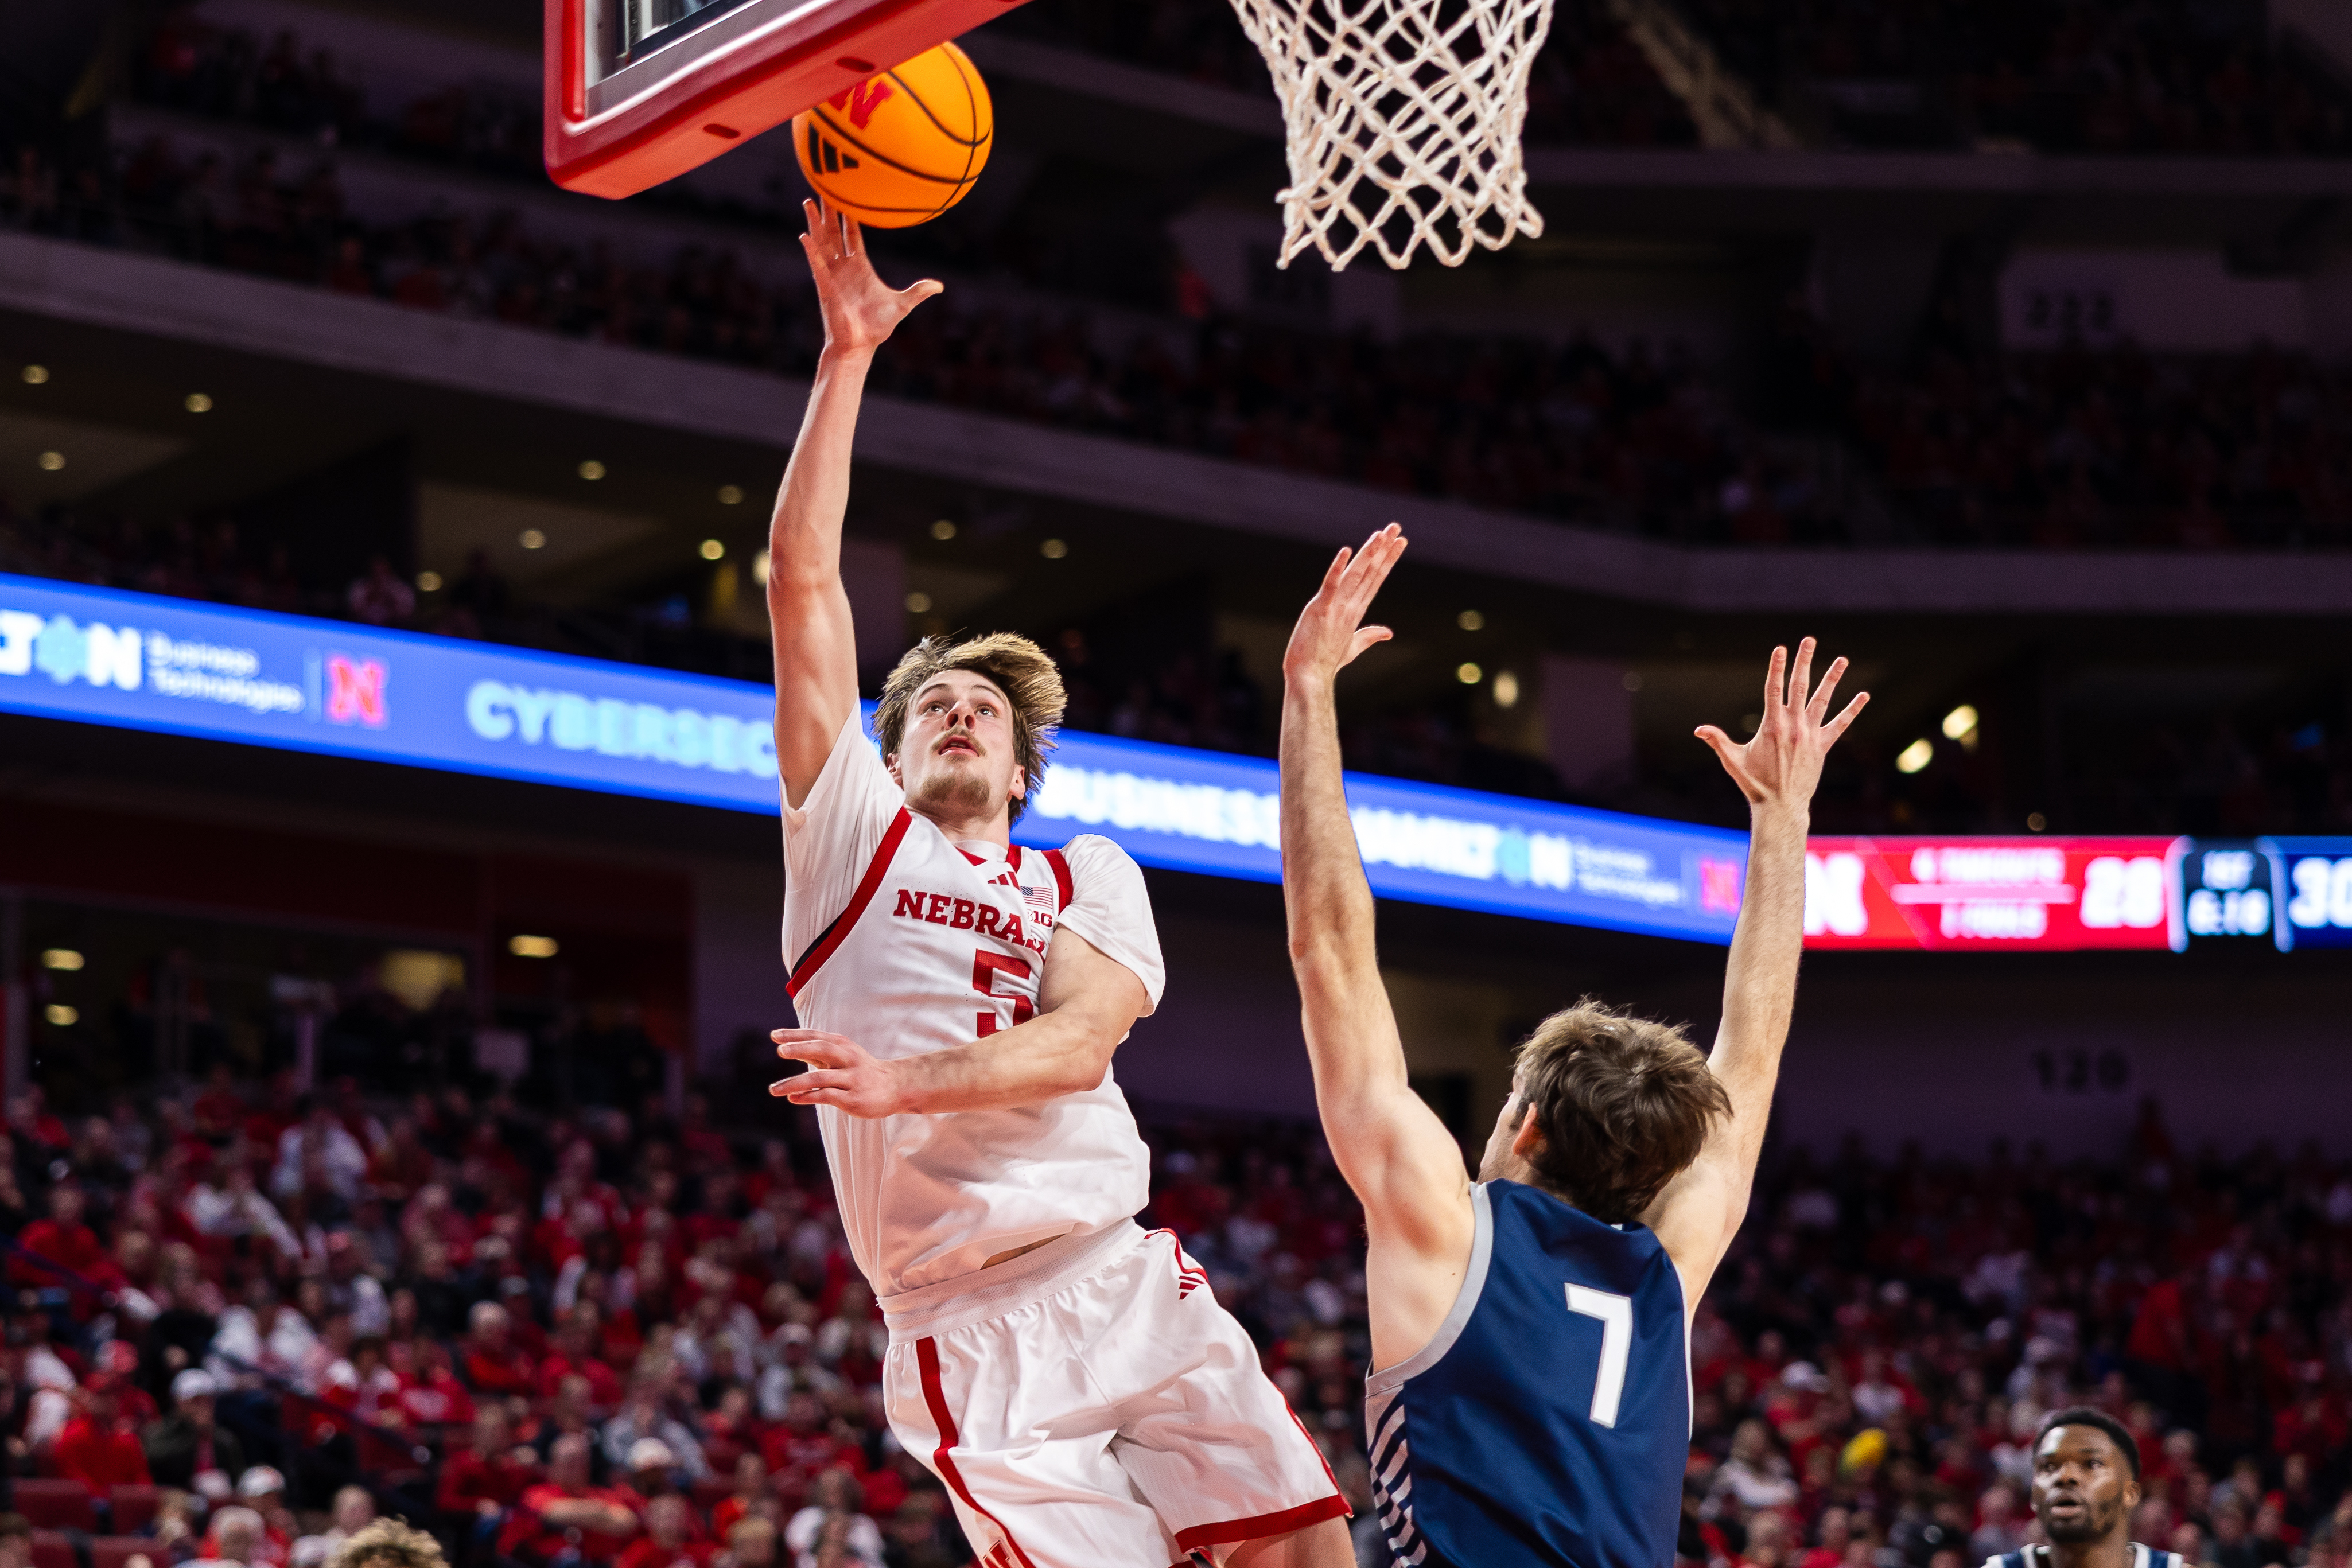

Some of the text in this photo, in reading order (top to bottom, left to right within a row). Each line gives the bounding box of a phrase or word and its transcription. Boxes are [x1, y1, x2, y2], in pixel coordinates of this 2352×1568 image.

[0, 610, 141, 690] TON
[329, 653, 390, 729] N
[972, 948, 1035, 1039] 5
[1564, 1282, 1632, 1429] 7
